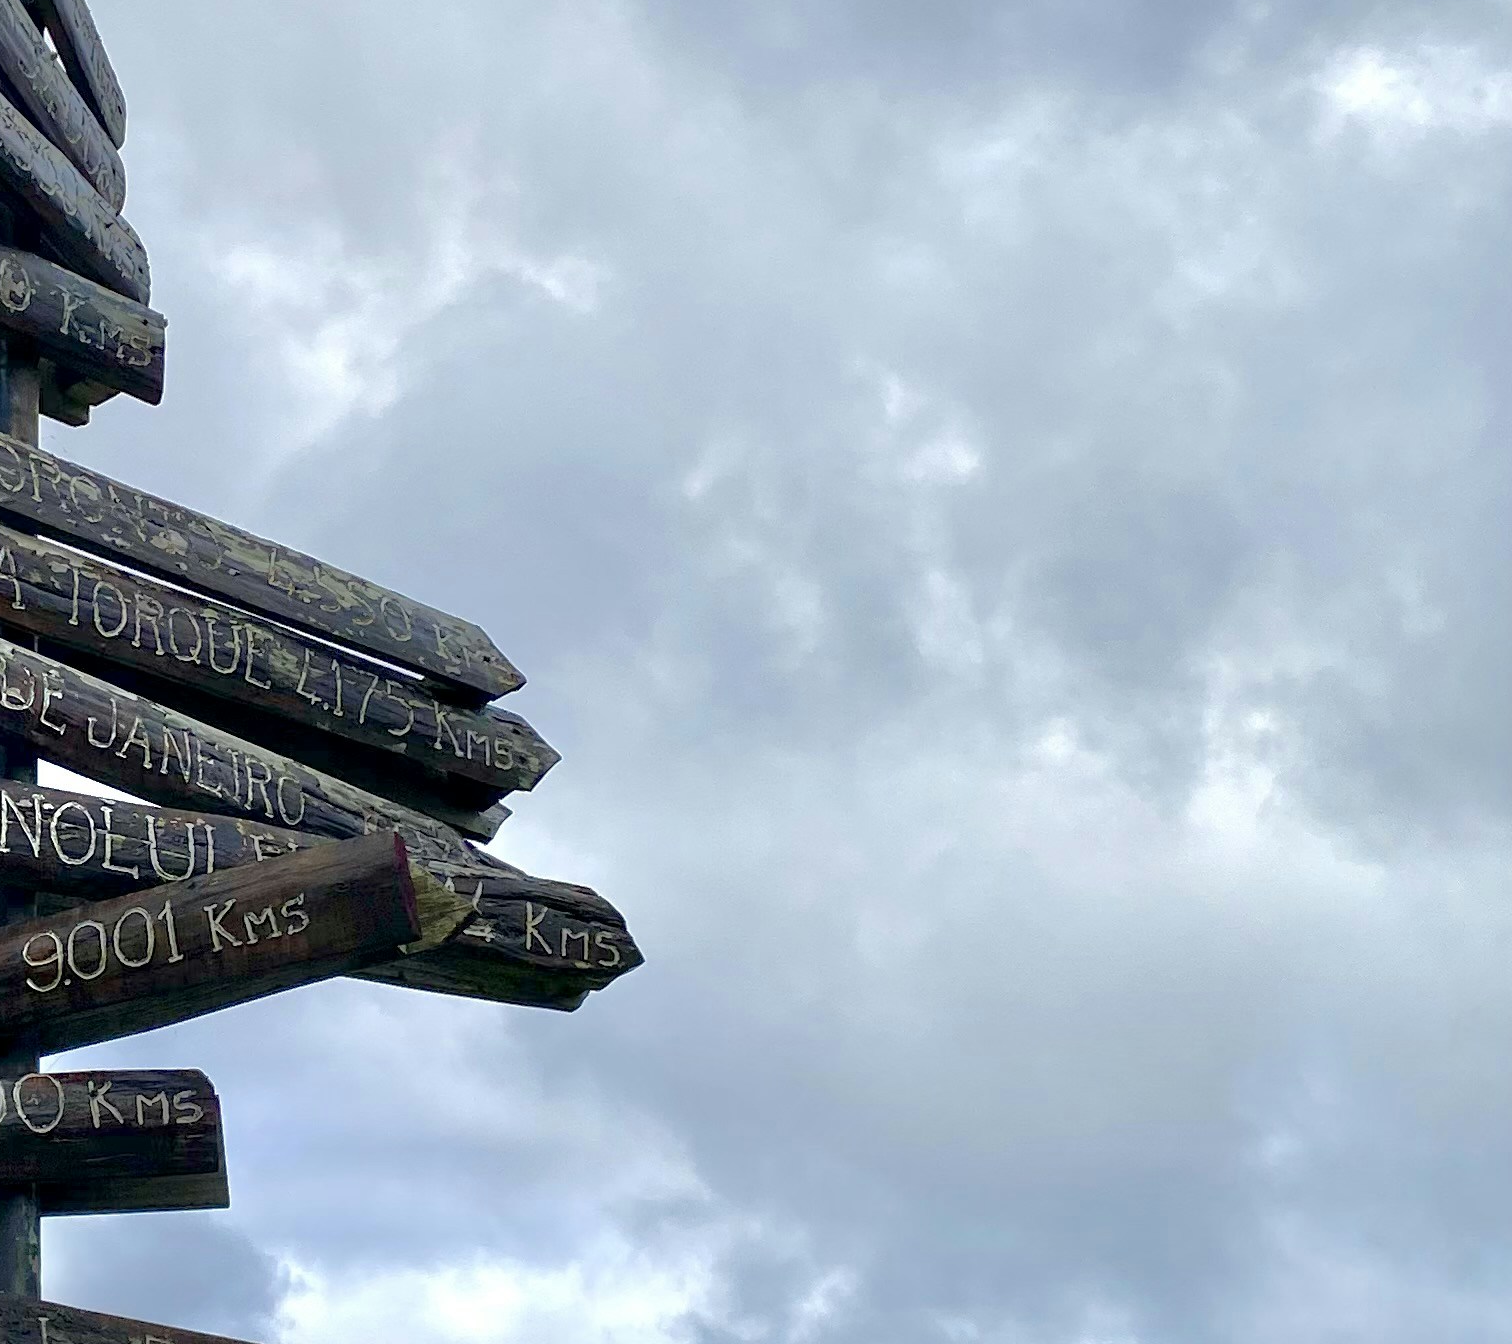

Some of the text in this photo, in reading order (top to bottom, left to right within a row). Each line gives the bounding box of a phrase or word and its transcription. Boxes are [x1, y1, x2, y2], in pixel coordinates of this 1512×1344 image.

[87, 697, 305, 826] JANEIRO
[432, 698, 514, 771] KMS
[22, 899, 185, 994] 9.001
[202, 892, 312, 954] KMS
[524, 900, 621, 968] KMS
[88, 1081, 206, 1129] KMS
